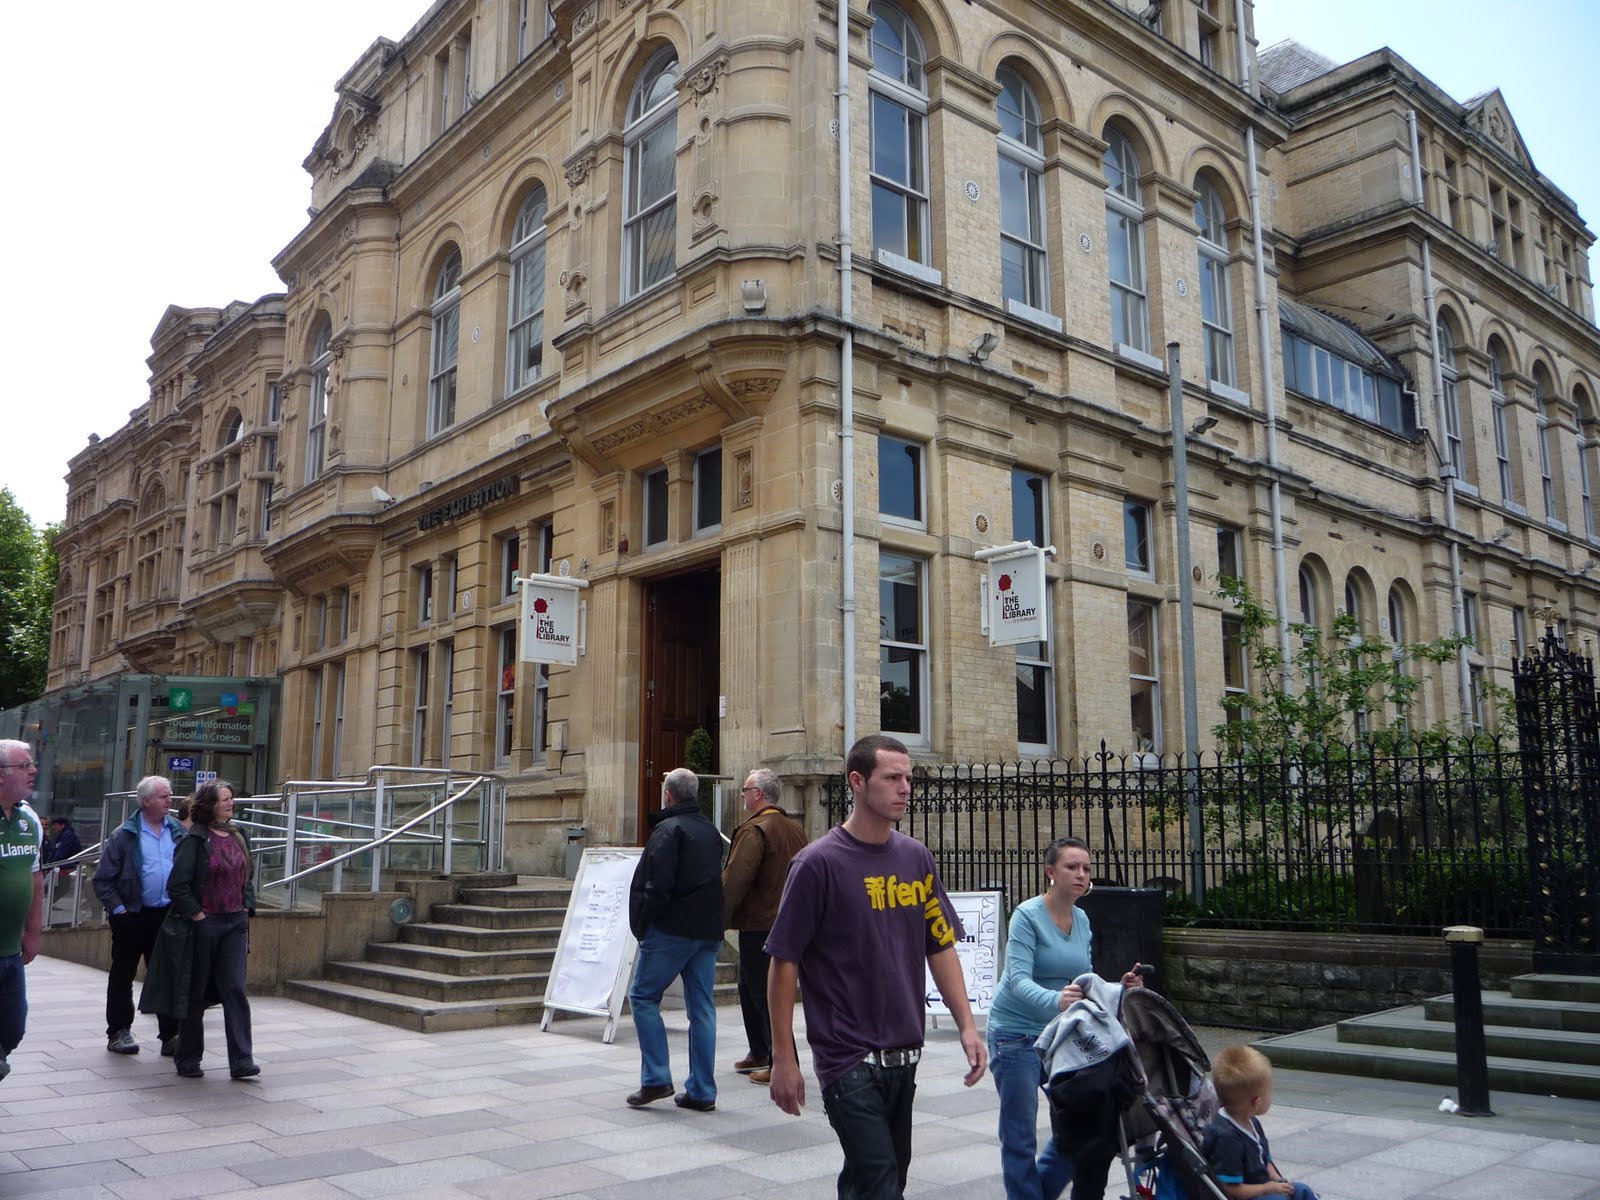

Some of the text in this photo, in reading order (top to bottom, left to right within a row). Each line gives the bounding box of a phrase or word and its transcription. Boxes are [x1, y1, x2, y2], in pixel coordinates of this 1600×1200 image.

[416, 475, 519, 532] THE EXHIBITION
[1005, 596, 1019, 605] THE
[1005, 603, 1020, 612] OLD
[1005, 607, 1036, 619] LIBRARY
[540, 619, 554, 628] THE
[539, 626, 555, 634] OLD
[539, 633, 570, 642] LIBRARY
[169, 719, 254, 731] Tourist Information
[167, 729, 241, 742] Canolfan Croeso
[1, 843, 38, 857] Llanera
